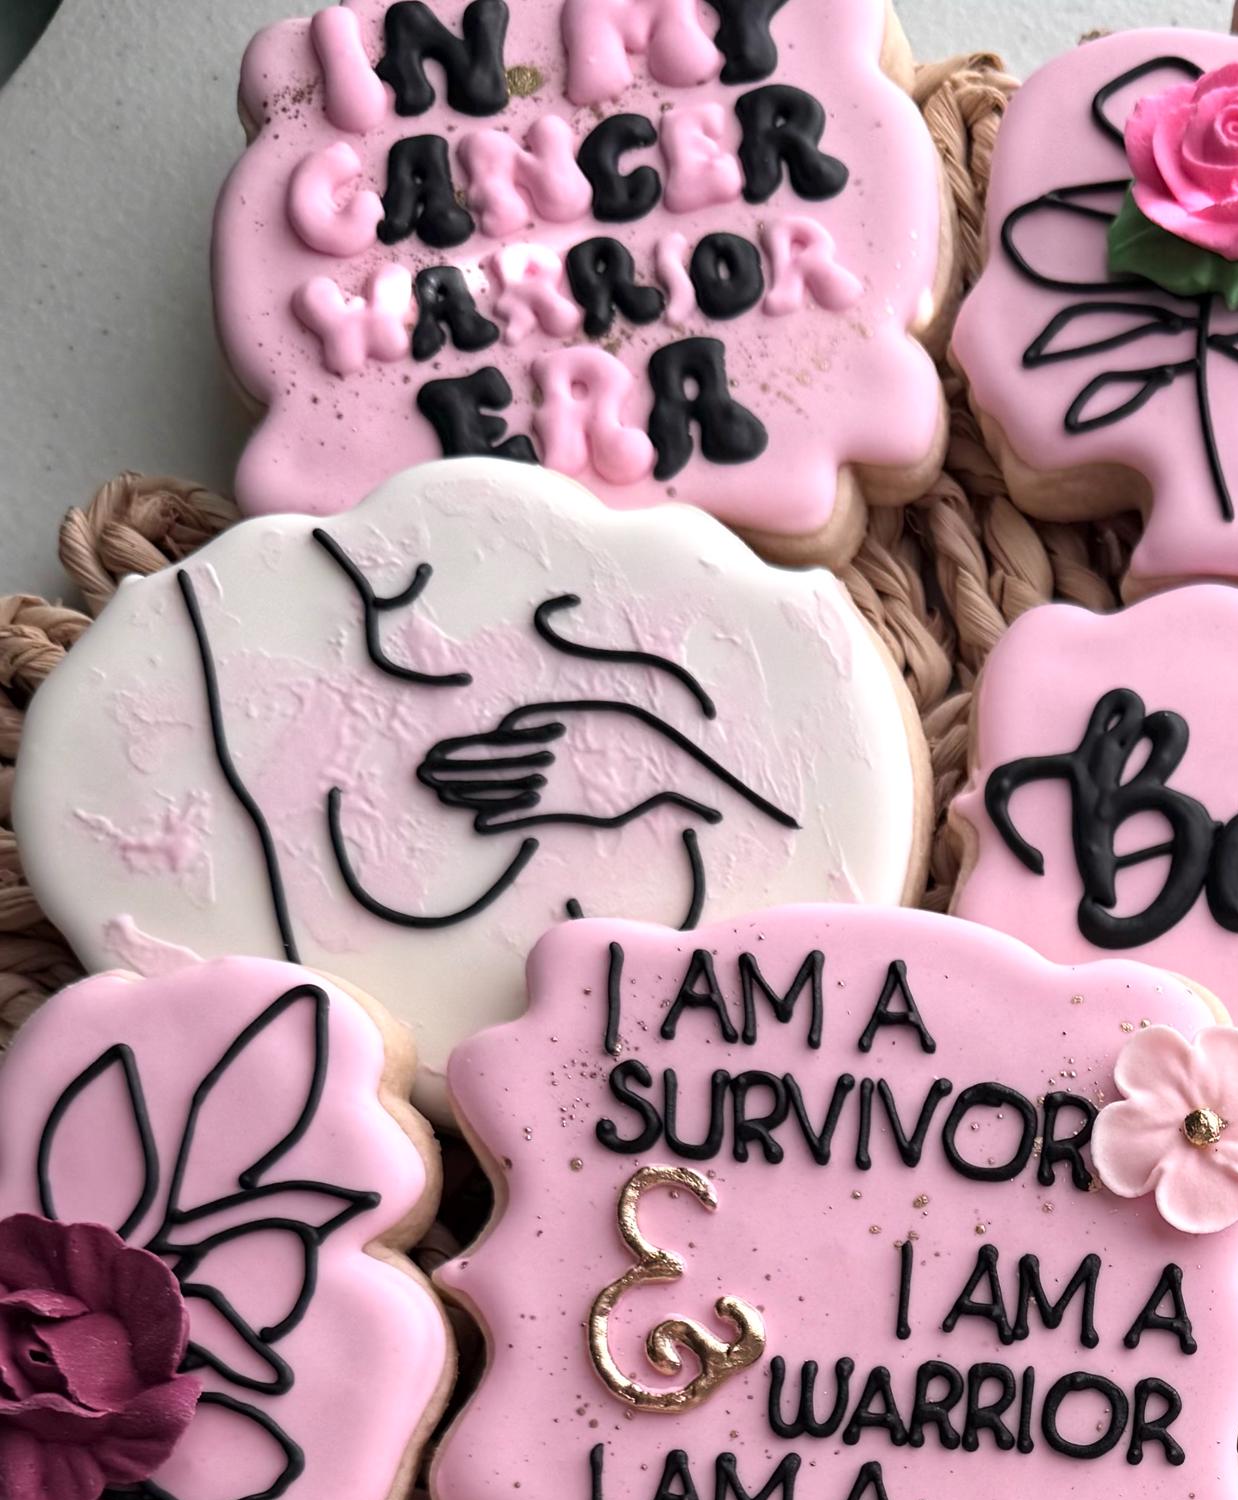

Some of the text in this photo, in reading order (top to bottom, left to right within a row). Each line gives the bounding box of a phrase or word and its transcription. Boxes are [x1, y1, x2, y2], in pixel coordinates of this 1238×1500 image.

[311, 0, 511, 133] IN
[288, 83, 850, 258] CANCER
[292, 216, 866, 378] WARRIOR
[416, 336, 769, 485] ERA
[600, 940, 937, 1056] I AM A
[594, 1059, 1098, 1192] SURVIVOR
[895, 1239, 1198, 1356] I AM A
[767, 1354, 1187, 1468] WARRIOR
